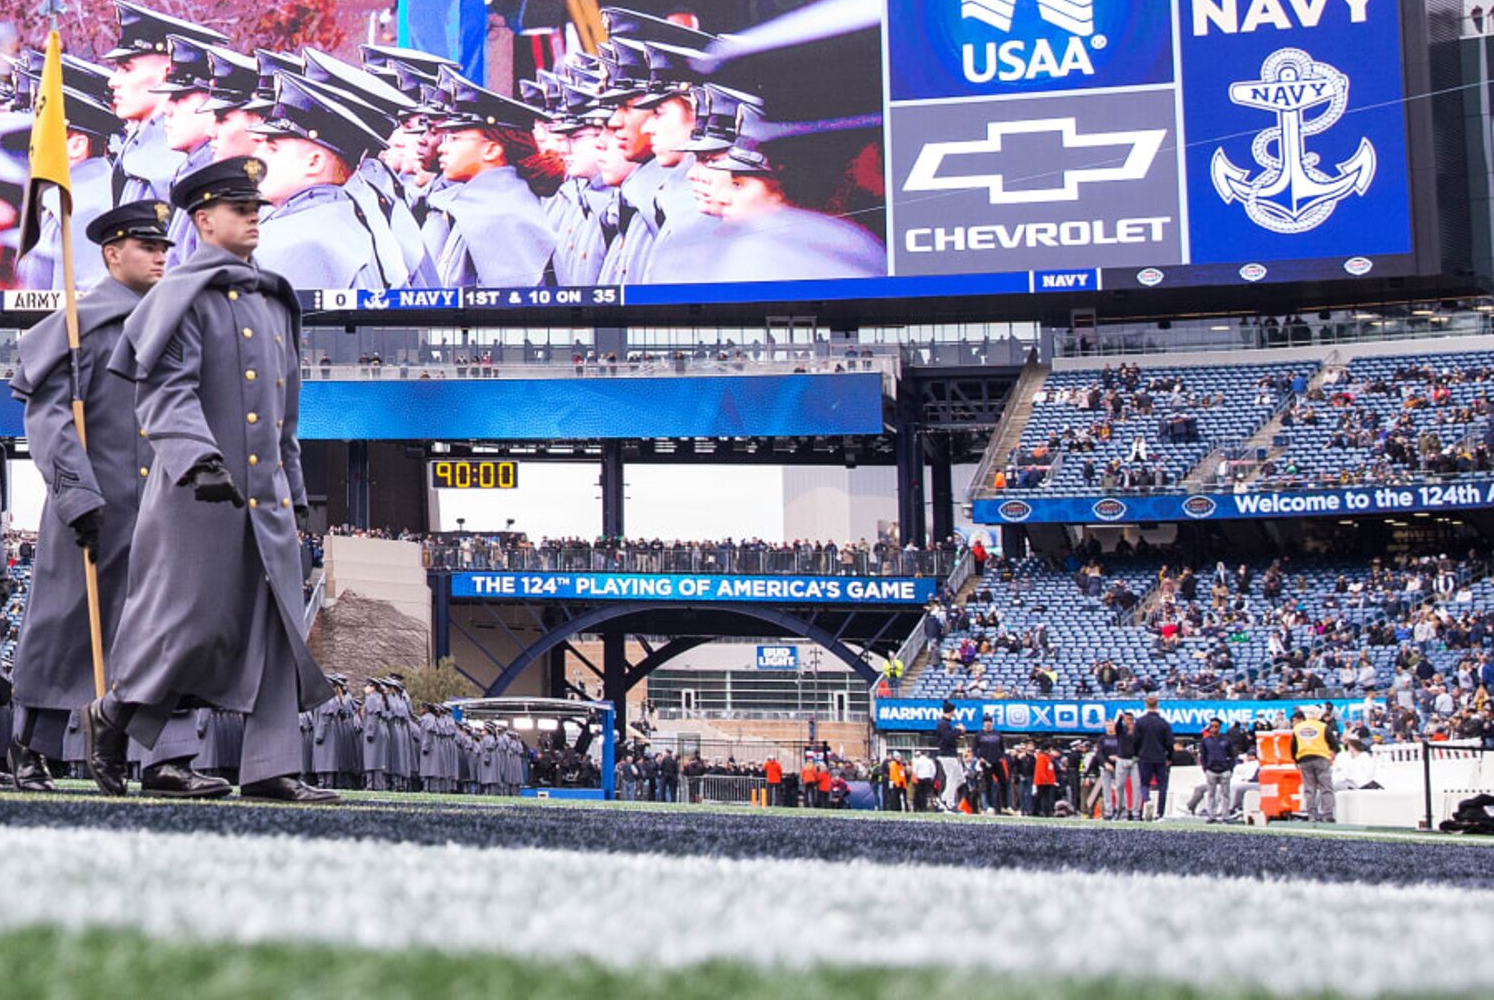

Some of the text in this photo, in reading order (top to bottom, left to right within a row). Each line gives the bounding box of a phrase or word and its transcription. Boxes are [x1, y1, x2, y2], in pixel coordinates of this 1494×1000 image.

[1250, 83, 1327, 106] NAVY
[905, 217, 1171, 253] CHEVROLET
[1042, 274, 1088, 288] NAVY
[14, 292, 61, 309] ARMY
[336, 295, 346, 306] 0
[400, 291, 455, 306] NAVY
[465, 289, 616, 305] 1ST & 10 ON 35
[436, 462, 514, 488] 90:00
[1234, 493, 1340, 514] Welcome
[1345, 491, 1370, 509] to
[1375, 488, 1413, 507] the
[1418, 484, 1481, 505] 124th
[472, 576, 515, 593] THE
[576, 578, 672, 595] PLAYING
[679, 579, 711, 596] OF
[717, 580, 841, 598] AMERICA'S
[846, 581, 915, 599] GAME
[879, 706, 976, 721] #ARMYNVY
